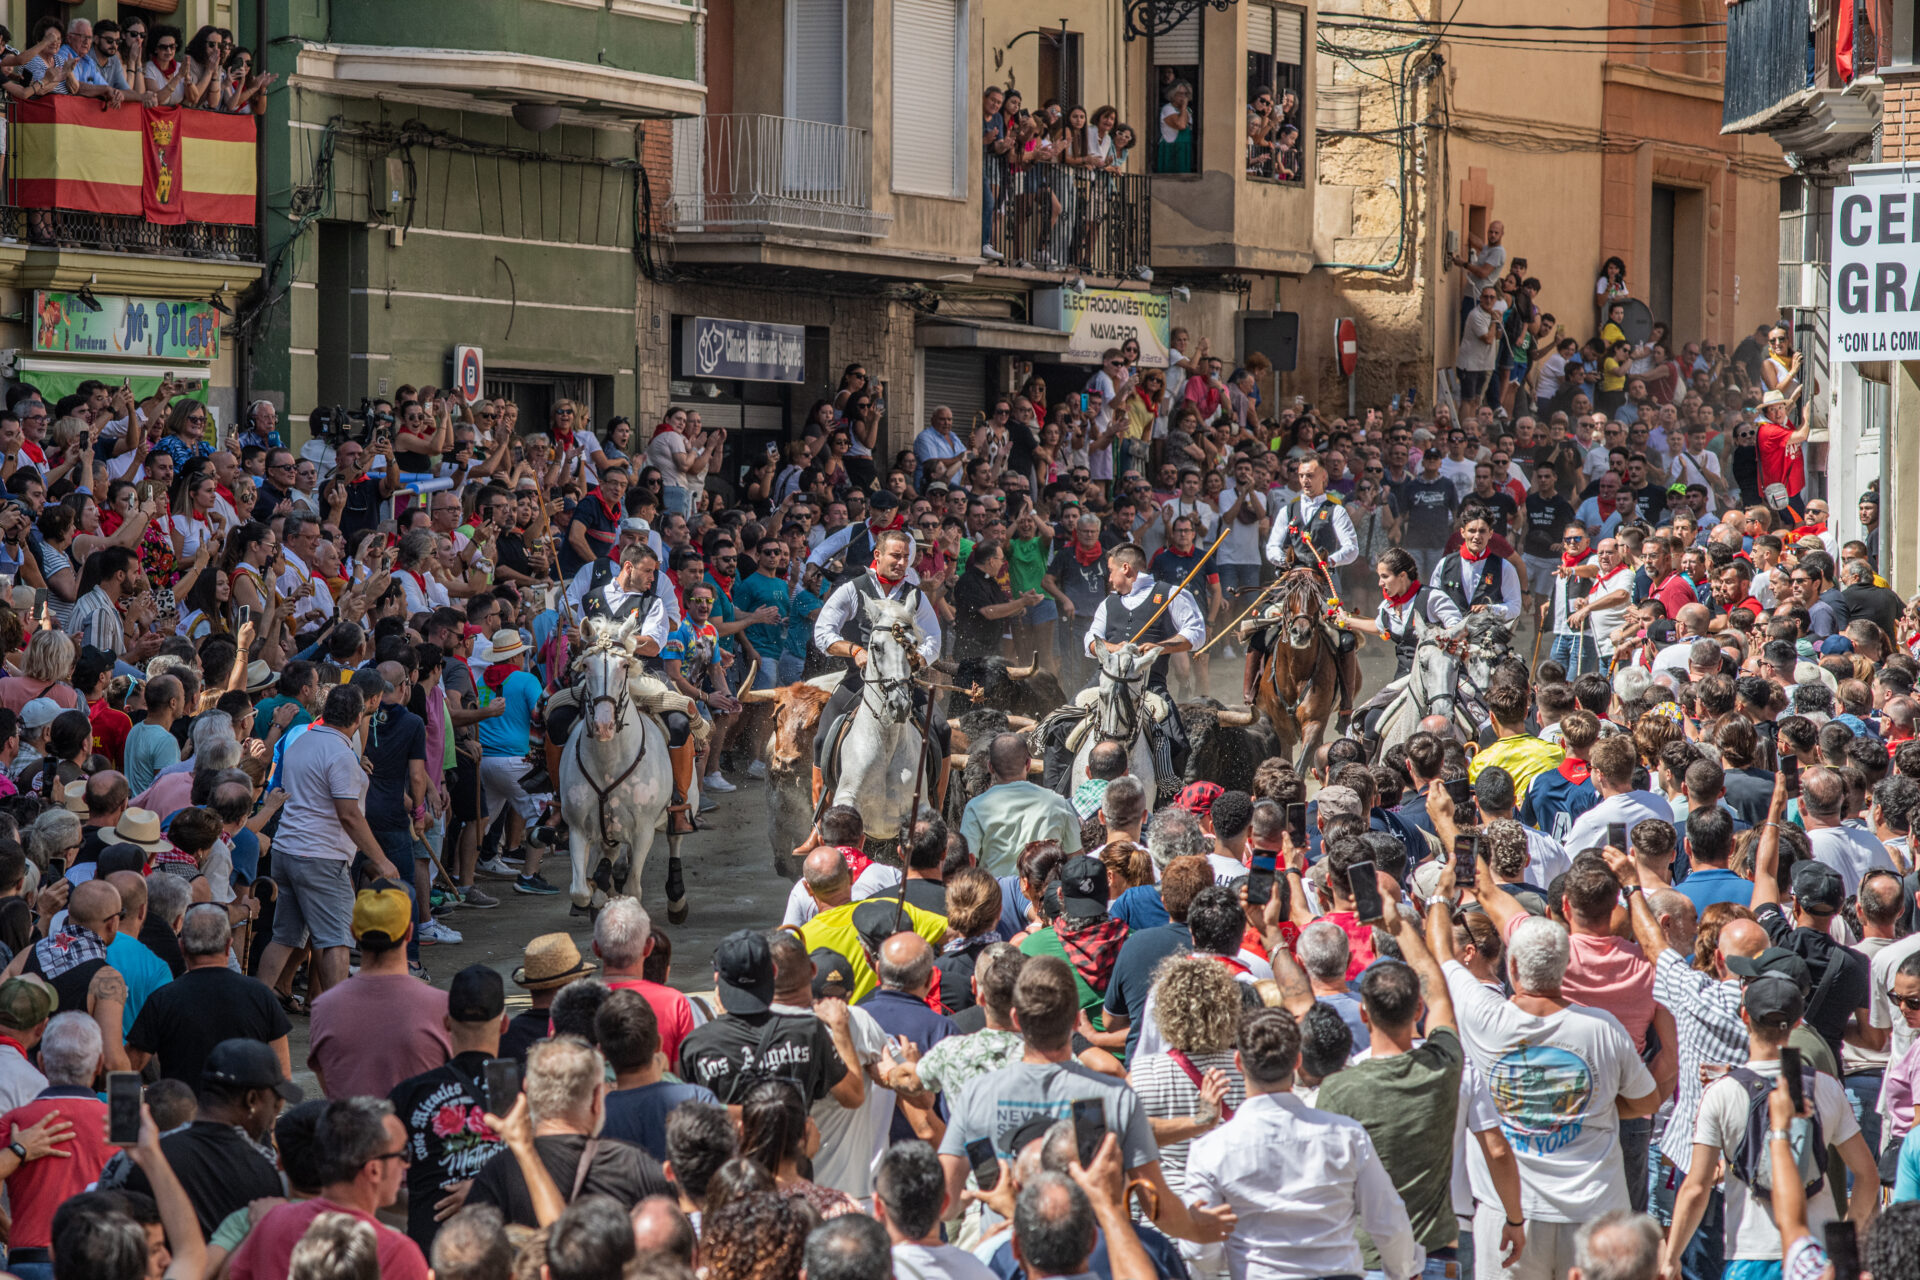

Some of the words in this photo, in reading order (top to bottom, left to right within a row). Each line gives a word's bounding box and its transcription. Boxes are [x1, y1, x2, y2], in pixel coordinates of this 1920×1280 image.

[1839, 193, 1920, 247] CE
[1063, 293, 1167, 319] ELECTRODOMÉSTICOS
[155, 301, 213, 356] Pilar
[1090, 323, 1138, 340] NAVARRO
[1872, 332, 1887, 351] LA
[1890, 330, 1920, 351] COM
